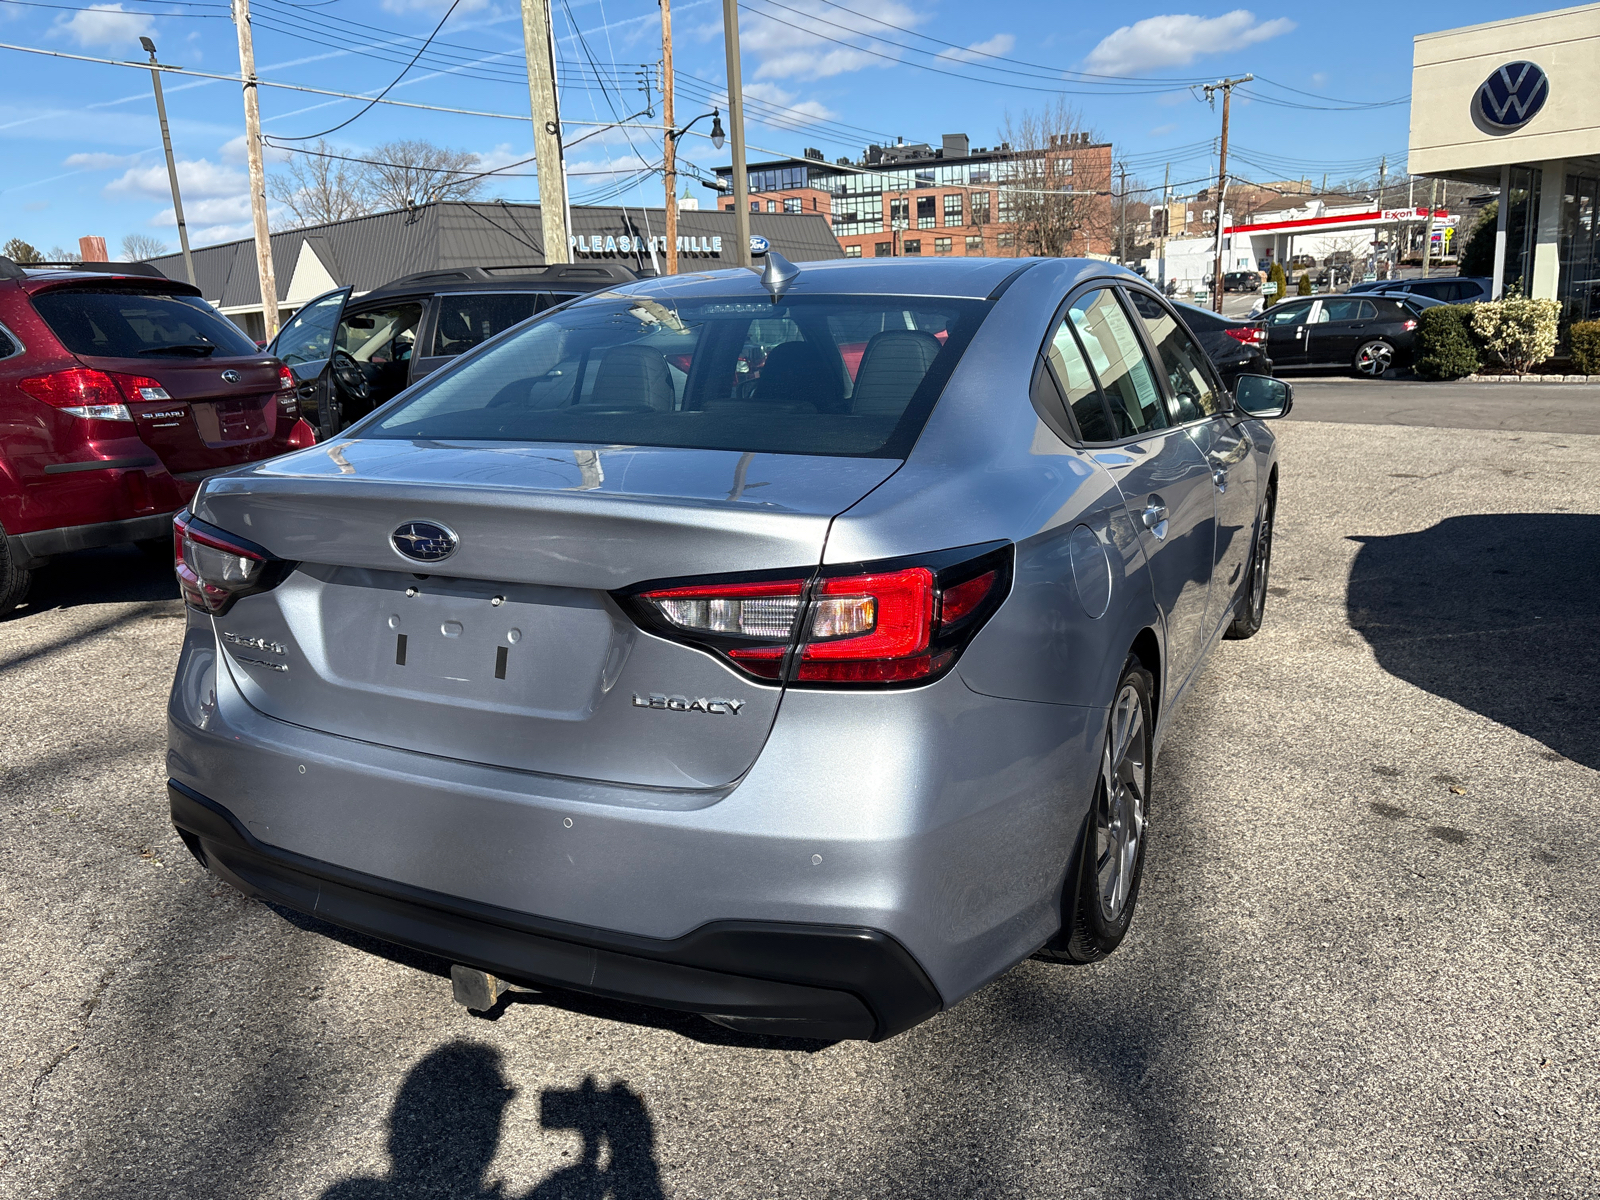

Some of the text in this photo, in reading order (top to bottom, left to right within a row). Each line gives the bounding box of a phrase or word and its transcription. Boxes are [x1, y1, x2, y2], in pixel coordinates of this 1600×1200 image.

[1384, 210, 1413, 220] Exxon
[141, 411, 185, 419] SUBARU
[632, 692, 746, 715] LEGACY
